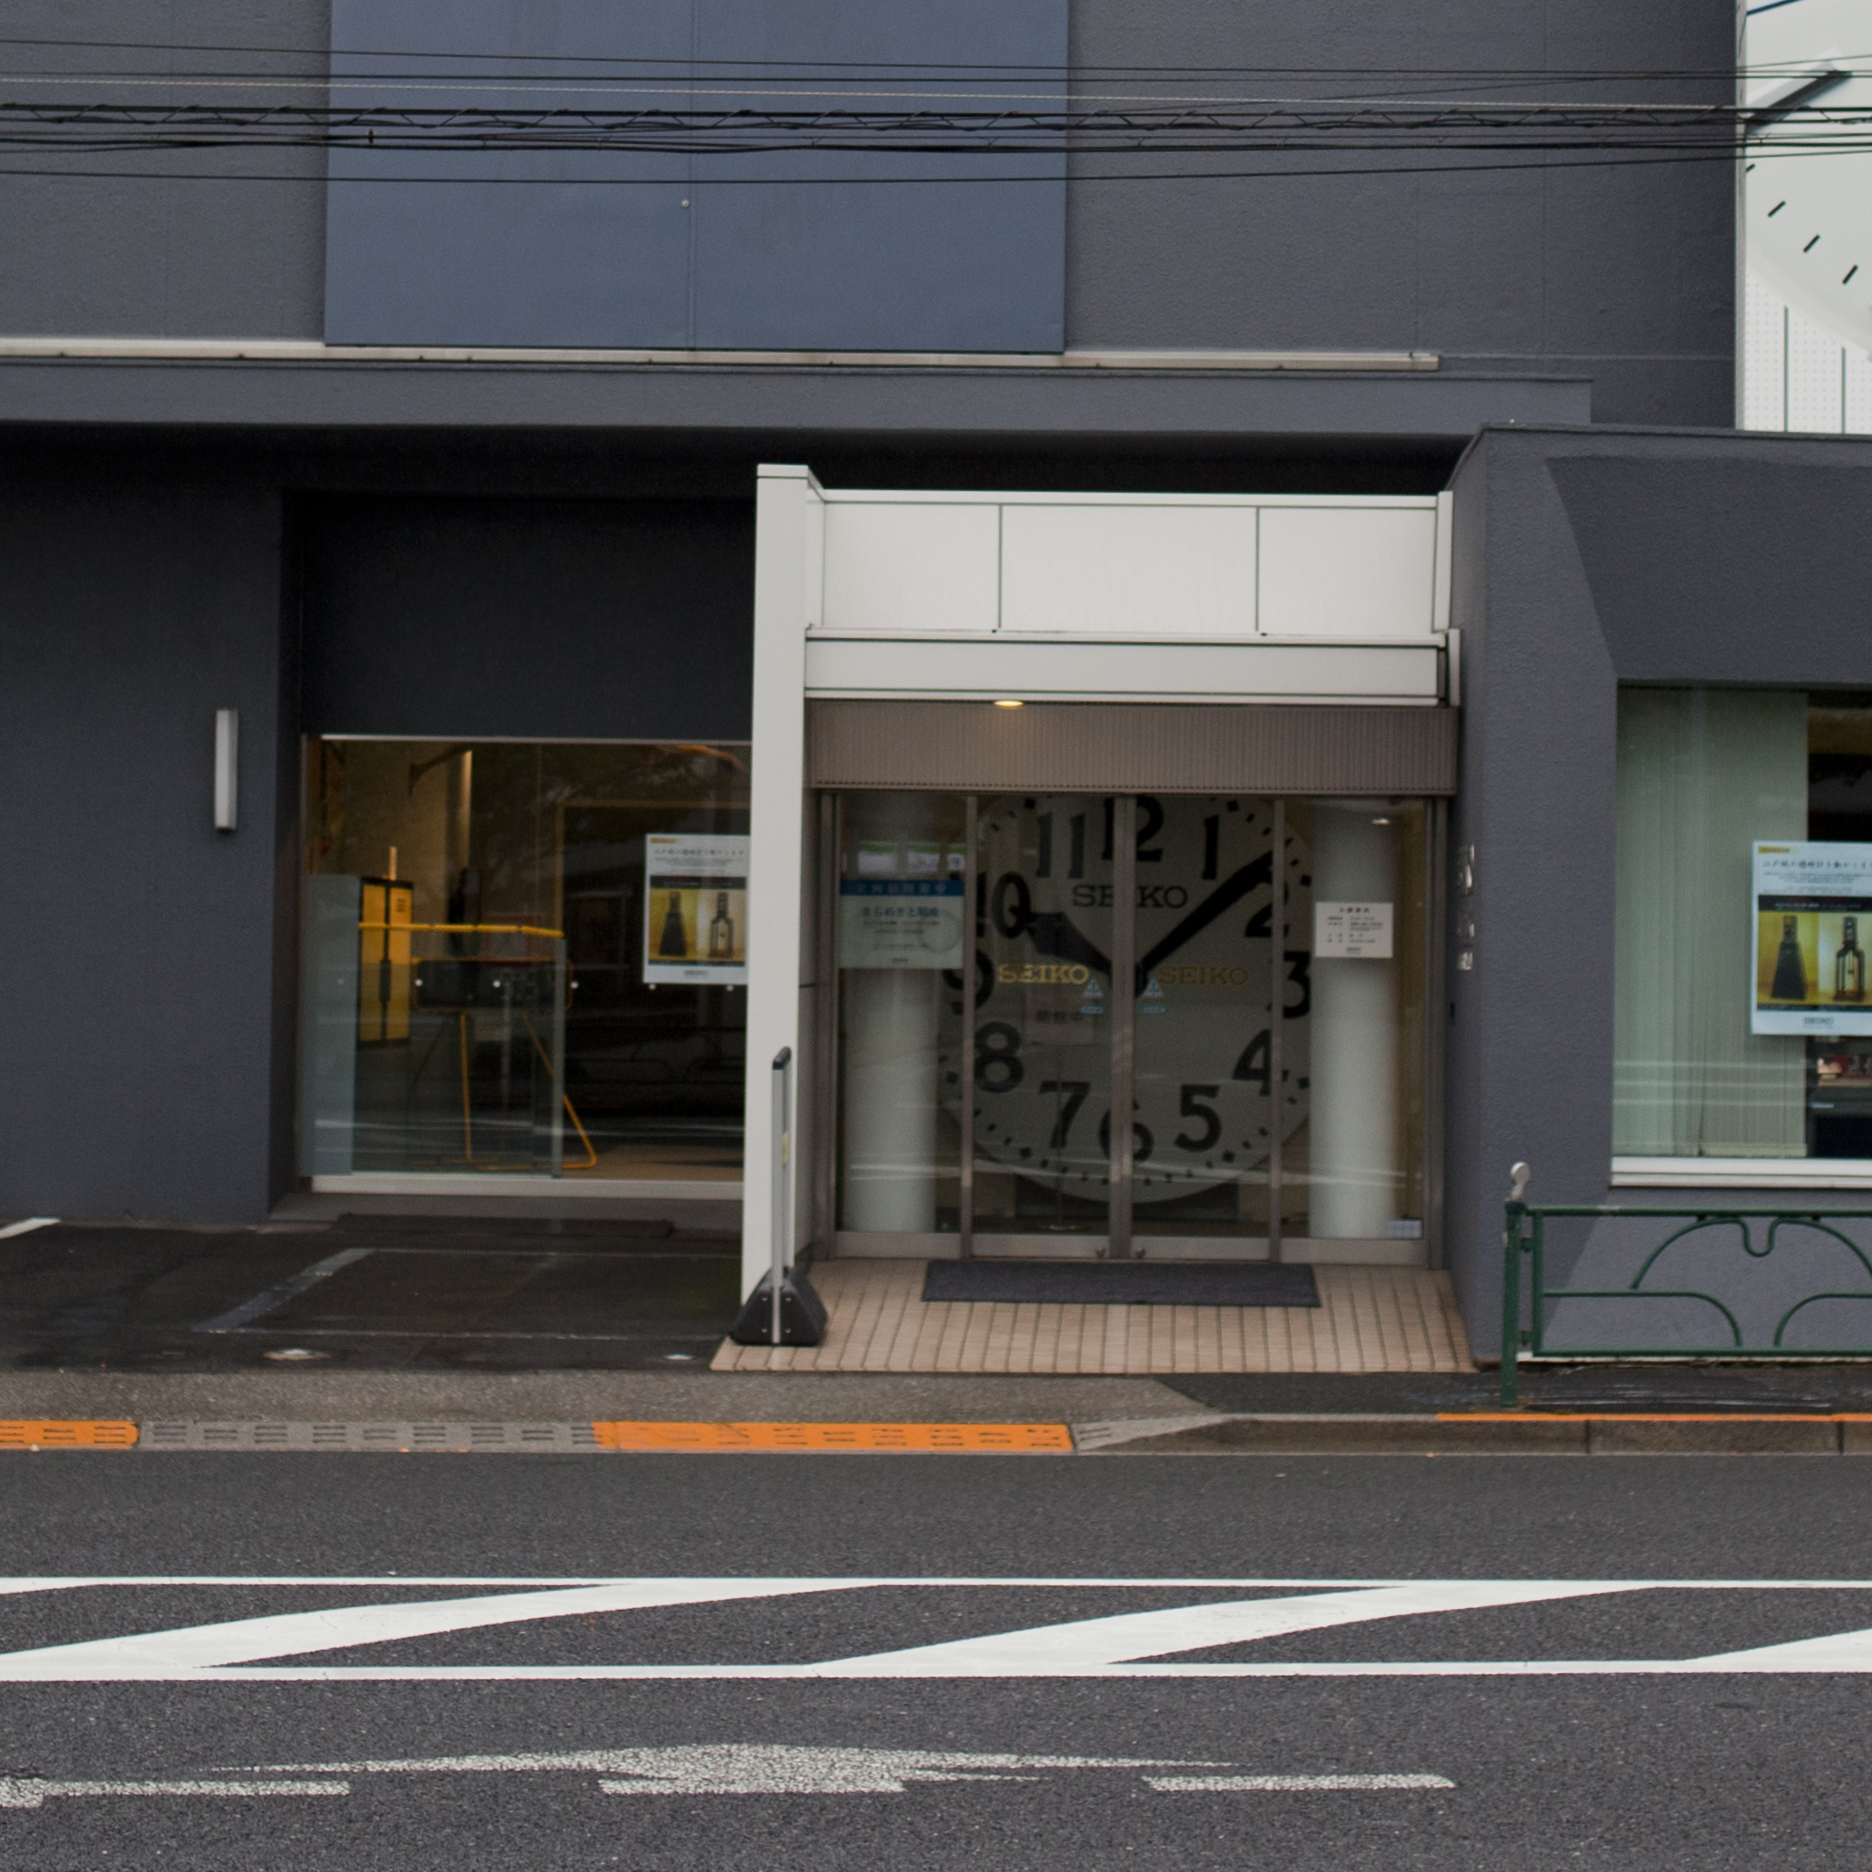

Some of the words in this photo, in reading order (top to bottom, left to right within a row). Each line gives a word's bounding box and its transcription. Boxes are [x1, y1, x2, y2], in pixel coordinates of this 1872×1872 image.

[1072, 884, 1188, 910] SEKO
[998, 963, 1090, 985] SEIKO
[1156, 965, 1250, 986] SEIKO
